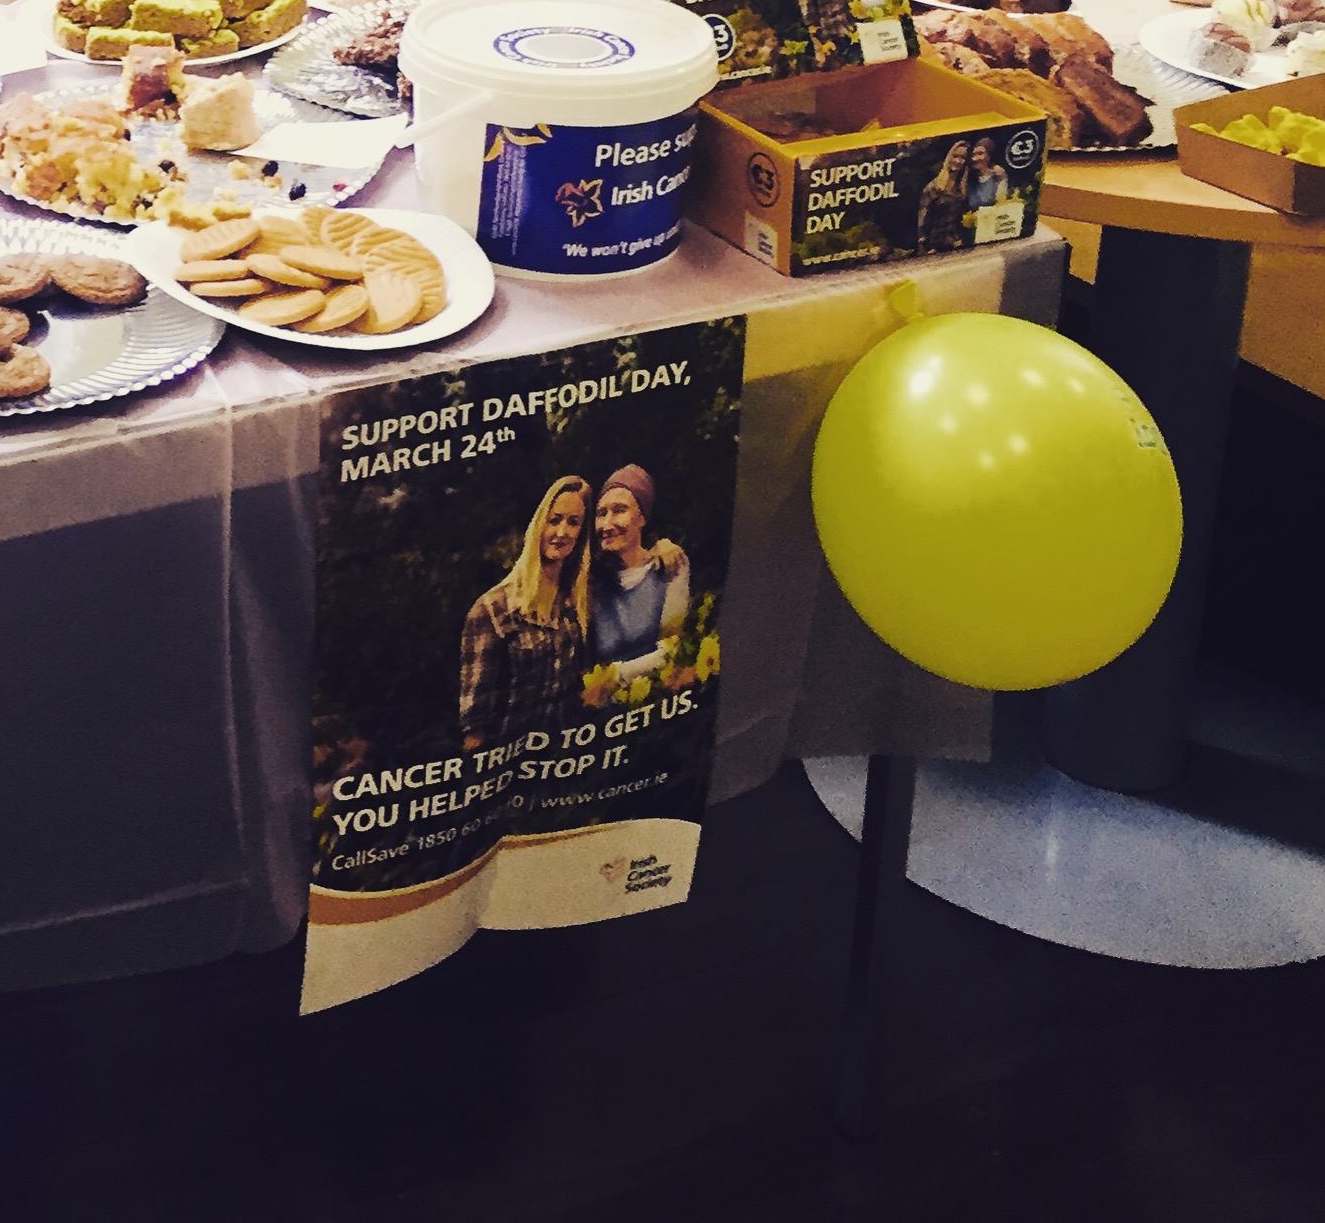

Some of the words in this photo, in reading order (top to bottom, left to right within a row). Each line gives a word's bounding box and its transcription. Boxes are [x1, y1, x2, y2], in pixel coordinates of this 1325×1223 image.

[595, 139, 672, 167] Please
[809, 158, 897, 188] SUPPORT
[611, 180, 654, 206] Irish
[807, 181, 900, 212] DAFFODIL
[805, 210, 846, 234] DAY
[341, 401, 474, 451] SUPPORT
[482, 375, 624, 423] DAFFODIL
[630, 361, 692, 394] DAY,
[340, 437, 451, 483] MARCH
[461, 425, 516, 461] 24th
[332, 757, 463, 801] CANCER
[473, 731, 550, 774] TRIED
[560, 723, 596, 749] TO
[604, 703, 655, 738] GET
[661, 689, 699, 720] US.
[332, 803, 399, 836] YOU
[409, 770, 514, 822] HELPED
[517, 753, 596, 780] STOP
[601, 744, 629, 770] IT.
[331, 843, 410, 871] CallSave
[418, 827, 457, 850] 1850
[461, 818, 481, 836] 60
[541, 771, 669, 809] www.cancer.ie
